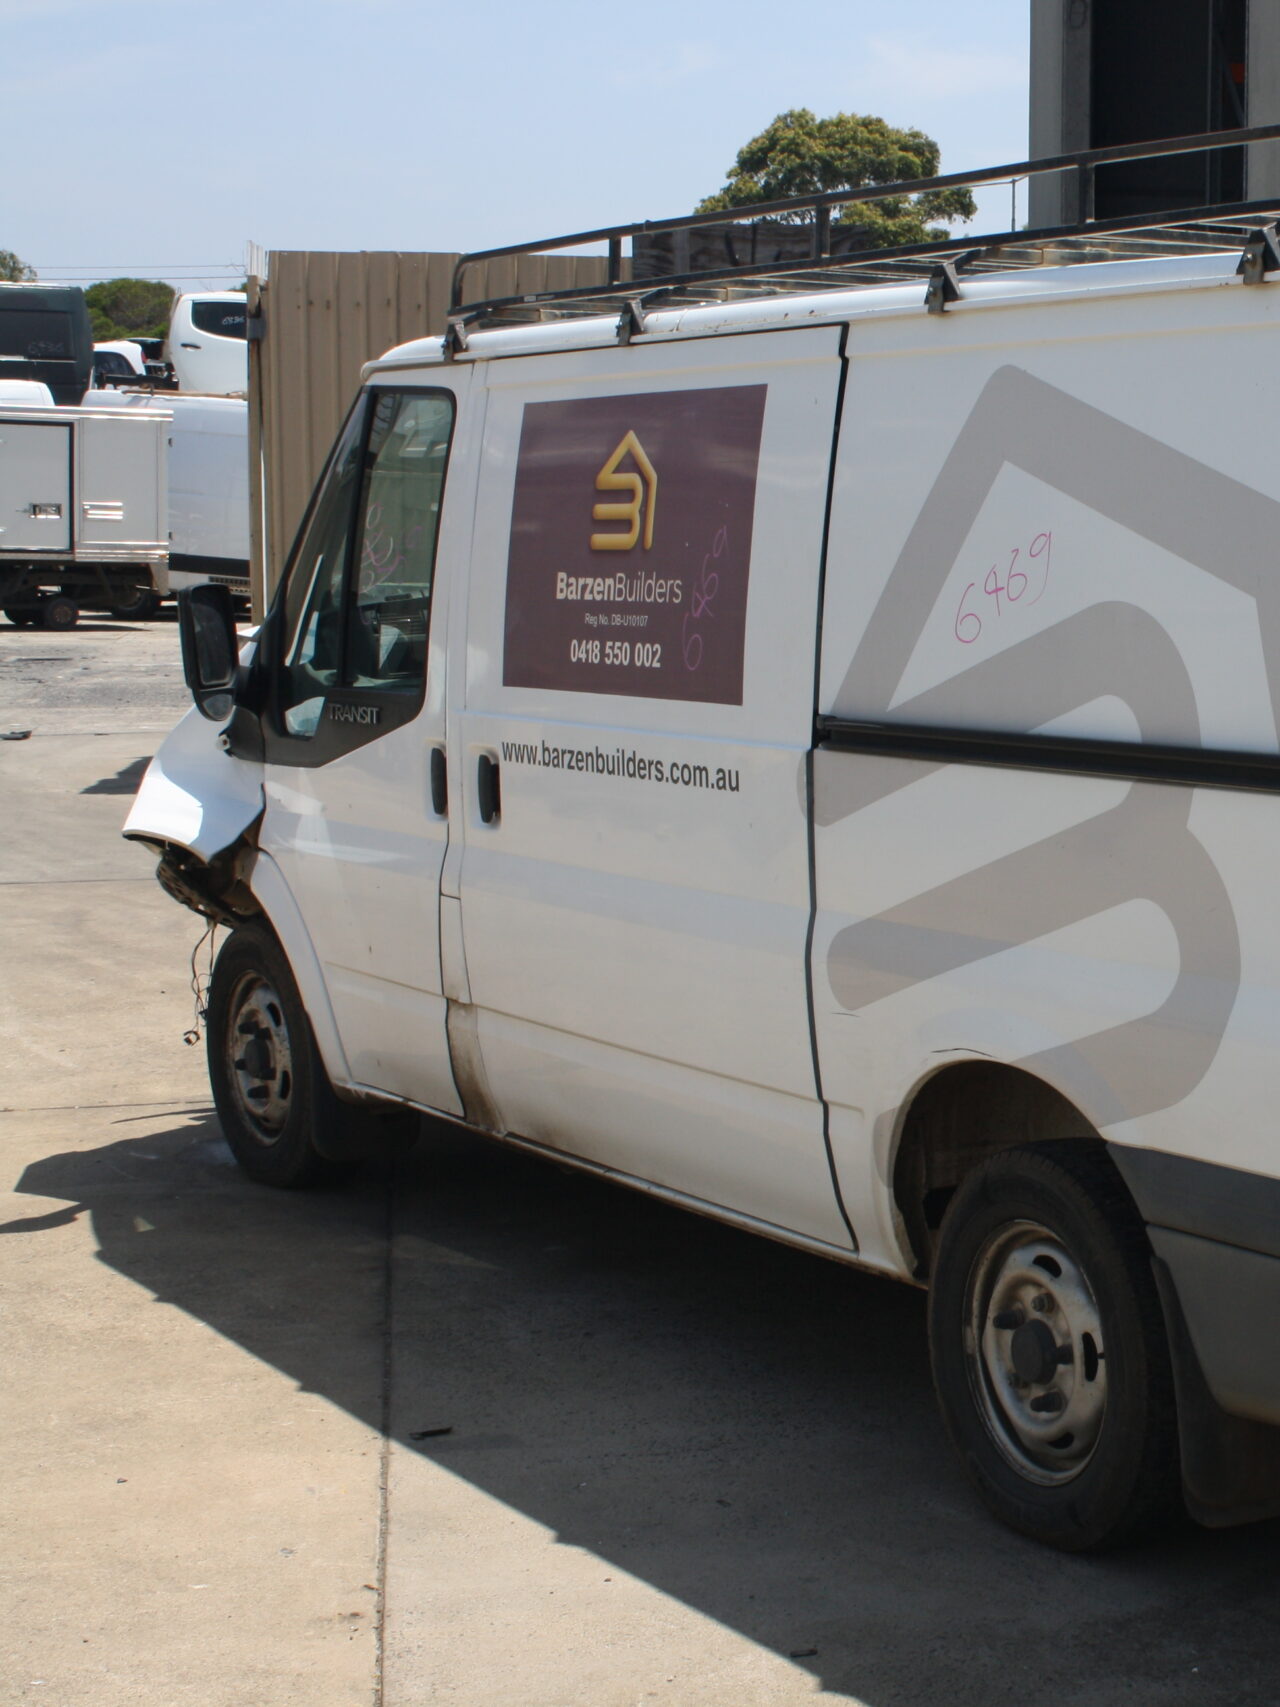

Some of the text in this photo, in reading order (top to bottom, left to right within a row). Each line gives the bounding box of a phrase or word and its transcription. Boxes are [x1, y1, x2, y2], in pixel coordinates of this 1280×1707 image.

[556, 571, 682, 604] BarzenBuilders
[682, 526, 729, 671] 6469
[954, 531, 1052, 643] 6469
[584, 612, 598, 627] Reg
[599, 614, 610, 626] No.
[570, 638, 662, 668] 0418 550 002
[327, 703, 379, 725] TRANSIT
[501, 740, 740, 793] www.barzenbuilders.com.au
